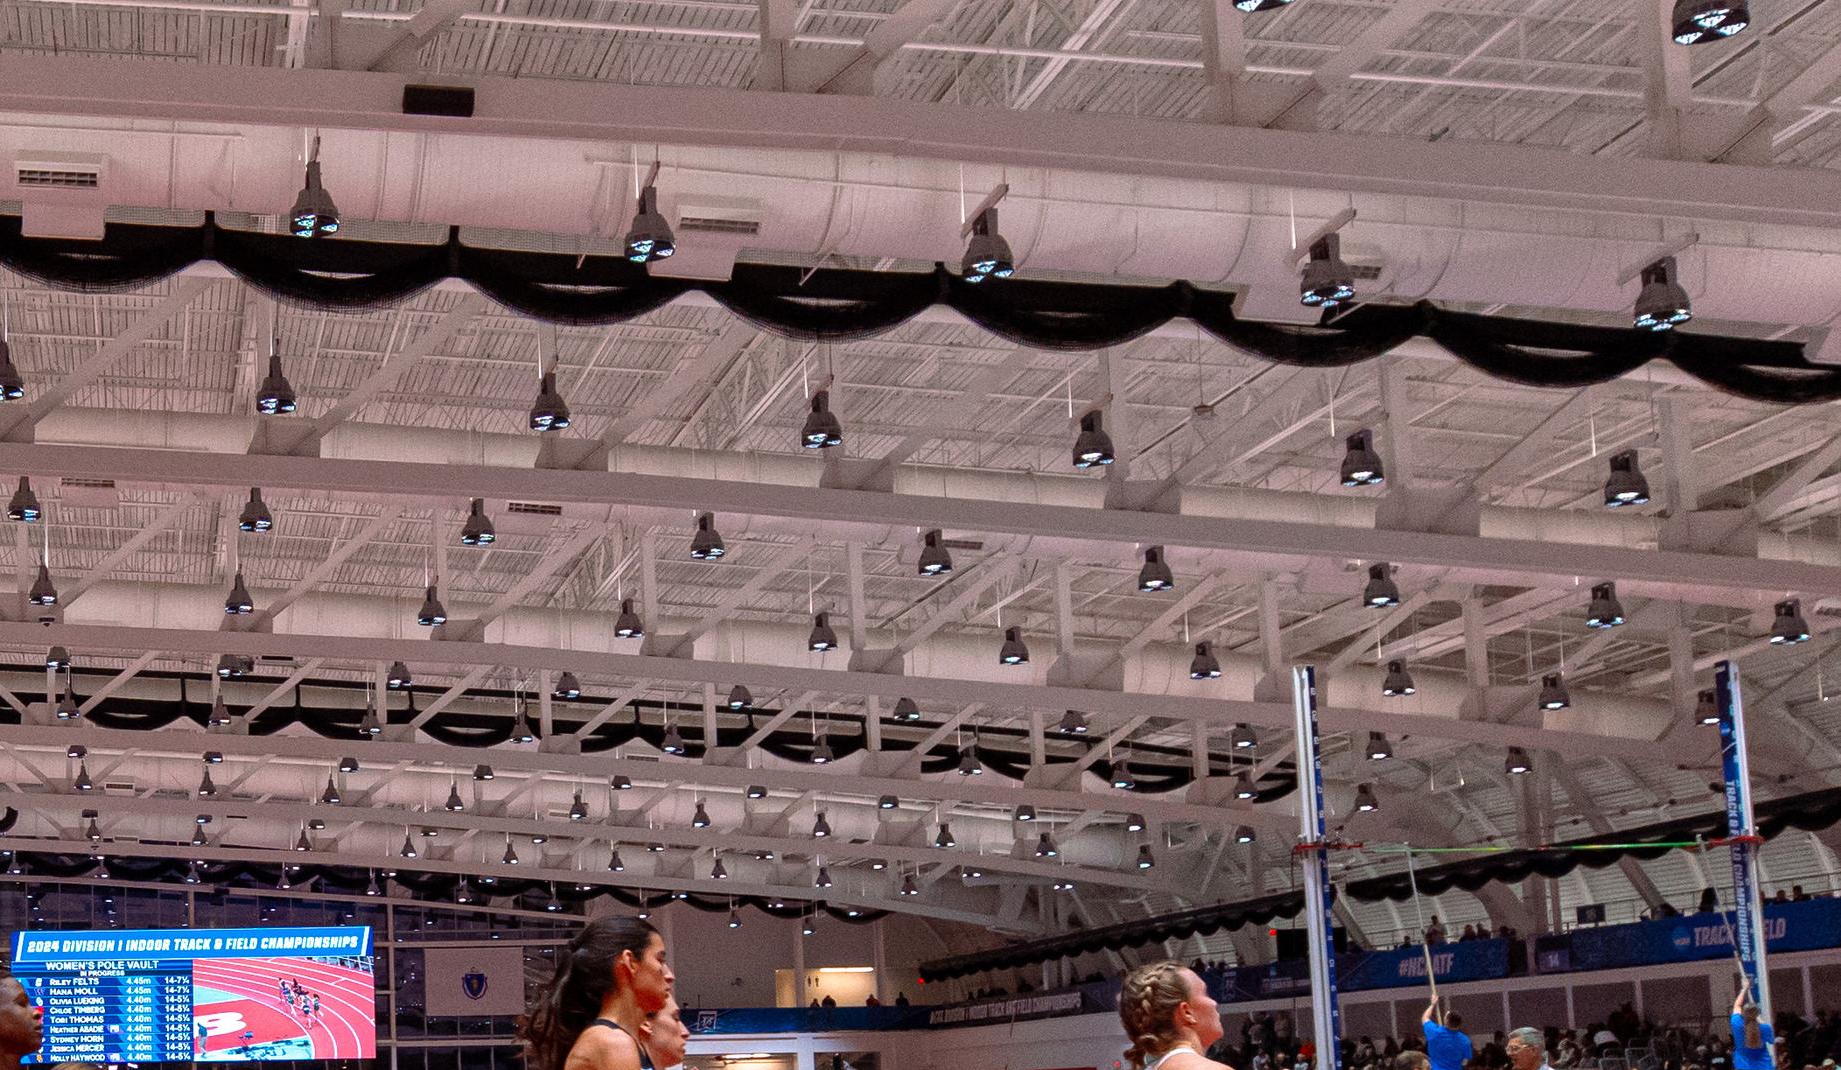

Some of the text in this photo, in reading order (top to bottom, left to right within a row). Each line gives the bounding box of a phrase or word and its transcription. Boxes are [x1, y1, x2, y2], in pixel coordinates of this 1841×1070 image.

[27, 940, 59, 953] 2024
[62, 940, 115, 952] DIVISION
[126, 939, 170, 951] INDOOR
[173, 938, 210, 951] TRACK
[226, 937, 258, 950] FIELD
[261, 935, 359, 949] CHAMPIONSHIPS
[46, 960, 160, 971] WOMEN'S POLE VAULT
[73, 978, 100, 986] FELTS
